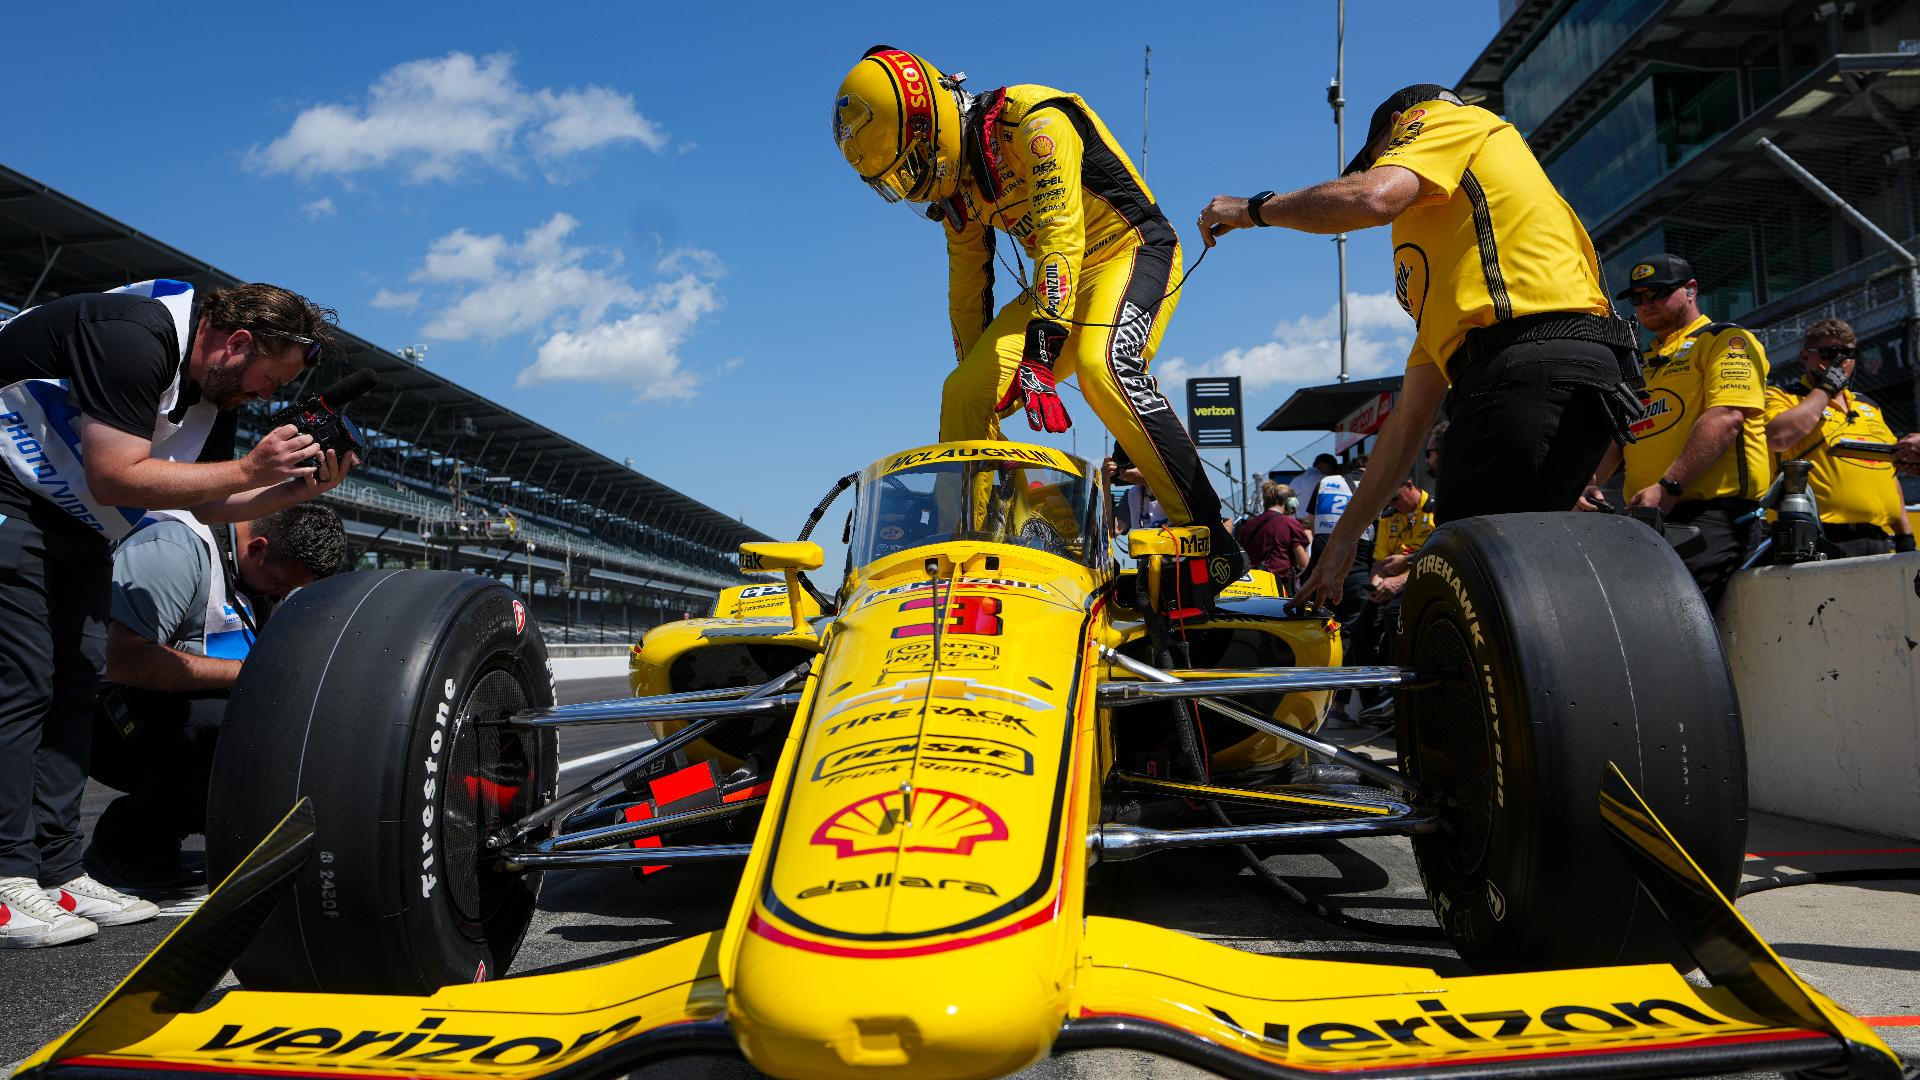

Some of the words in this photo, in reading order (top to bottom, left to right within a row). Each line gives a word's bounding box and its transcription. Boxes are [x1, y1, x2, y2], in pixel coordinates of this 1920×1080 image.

[886, 53, 927, 107] SCOTT
[1194, 405, 1235, 416] verizon
[887, 448, 1061, 472] MCLAUGHLIN
[890, 595, 1003, 639] 3
[1416, 554, 1486, 648] FIREHAWK
[943, 642, 990, 651] NTT
[830, 742, 1017, 767] PENSKE
[421, 678, 457, 898] Firestone
[796, 872, 1000, 899] dallara
[196, 1014, 642, 1067] verizon
[1206, 998, 1727, 1053] verizon
